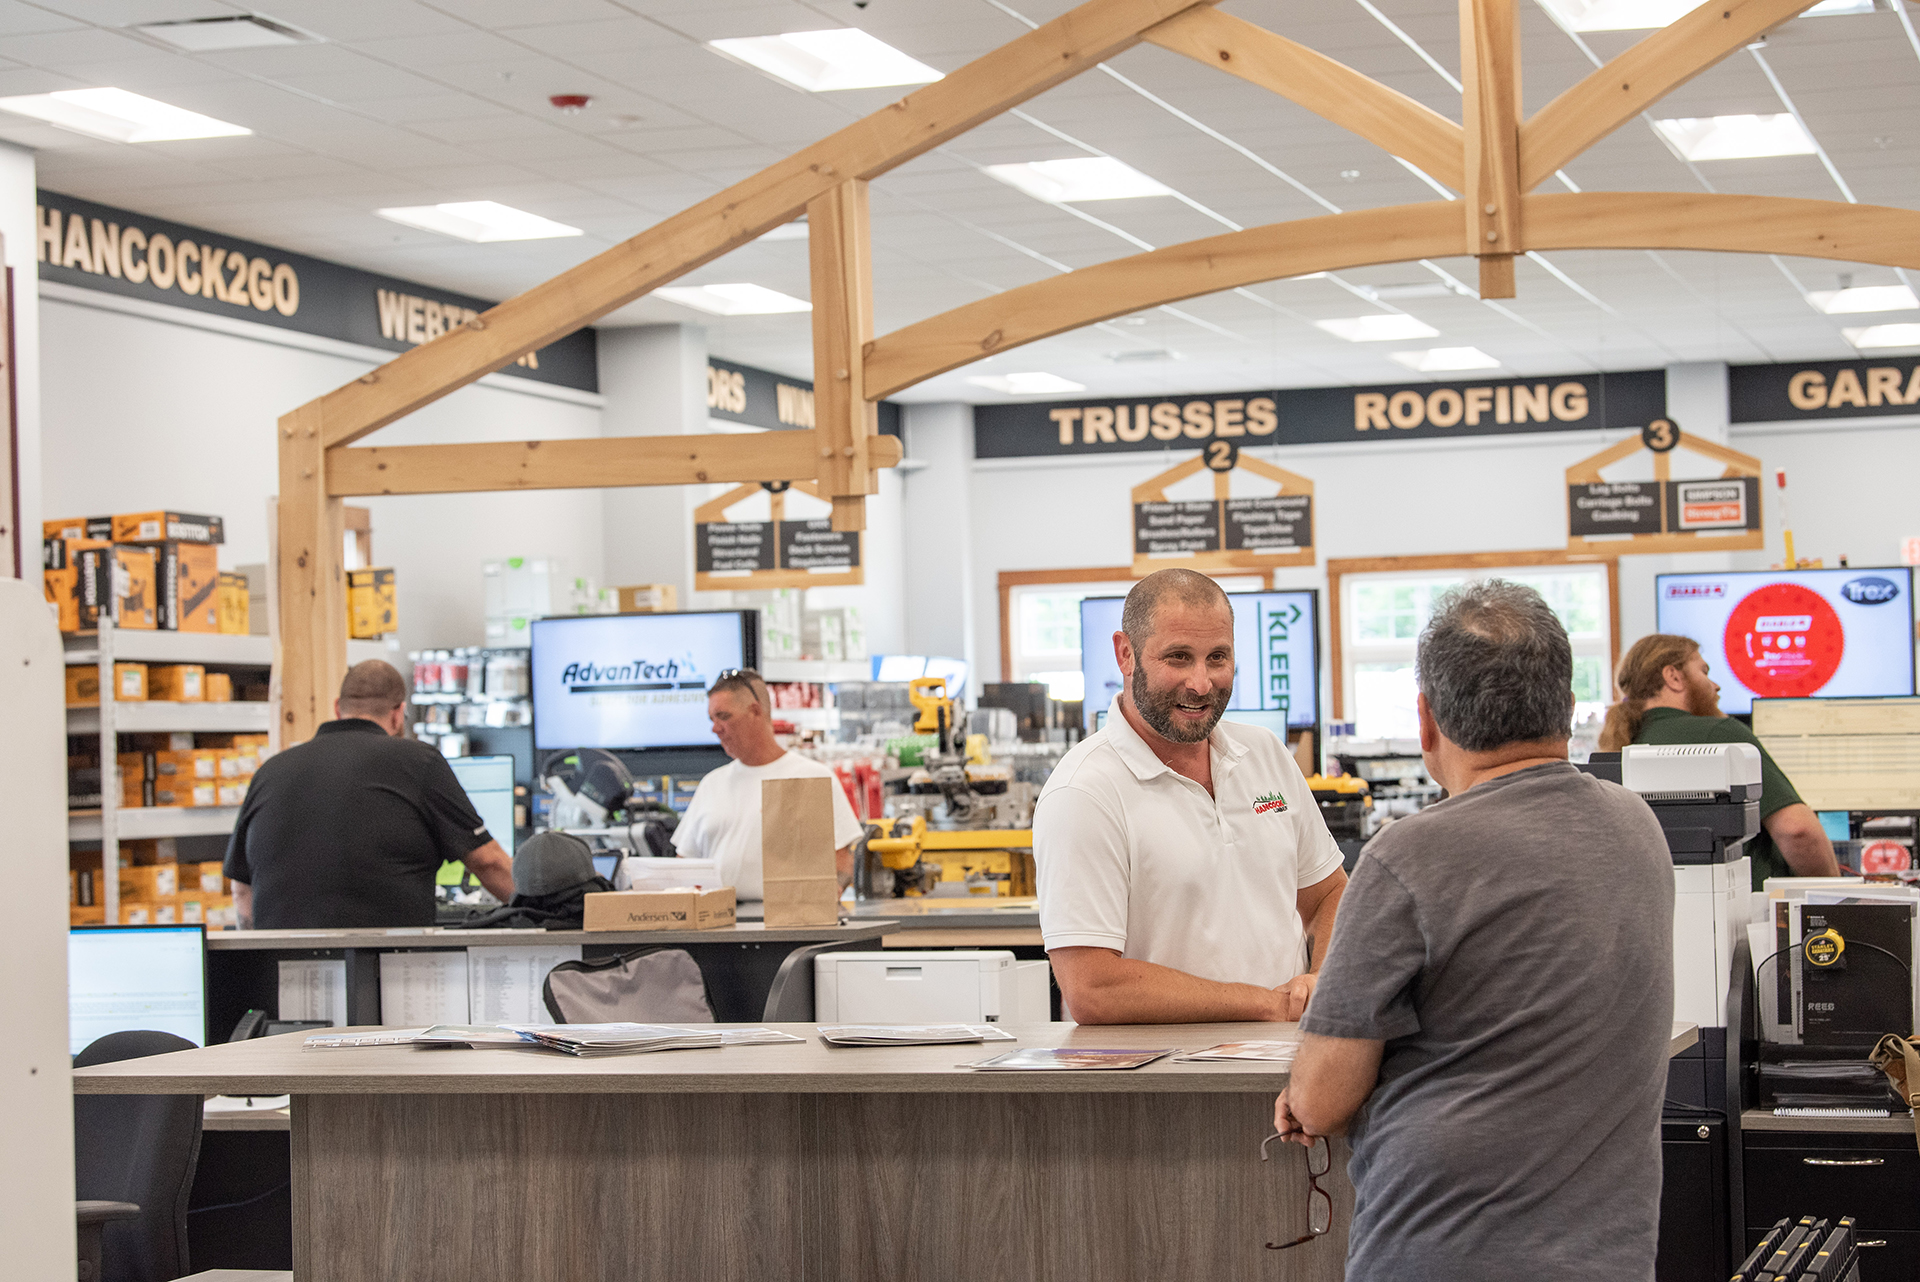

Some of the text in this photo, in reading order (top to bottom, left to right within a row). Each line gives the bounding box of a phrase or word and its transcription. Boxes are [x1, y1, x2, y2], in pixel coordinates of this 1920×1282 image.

[37, 205, 300, 317] HANCOCK2GO
[1354, 382, 1589, 431] ROOFING
[1049, 398, 1278, 445] TRUSSES
[1648, 419, 1673, 449] 3
[1208, 441, 1232, 469] 2
[1612, 483, 1641, 494] Bolts
[1687, 489, 1737, 500] SIMPSON
[1577, 495, 1654, 509] Carriage Bolts
[1591, 510, 1640, 522] Caulking
[1845, 581, 1894, 602] Trex
[563, 659, 679, 684] AdvanTech
[1268, 611, 1291, 710] KLEER
[1254, 800, 1285, 815] HANCOCK
[627, 912, 669, 922] Andersen
